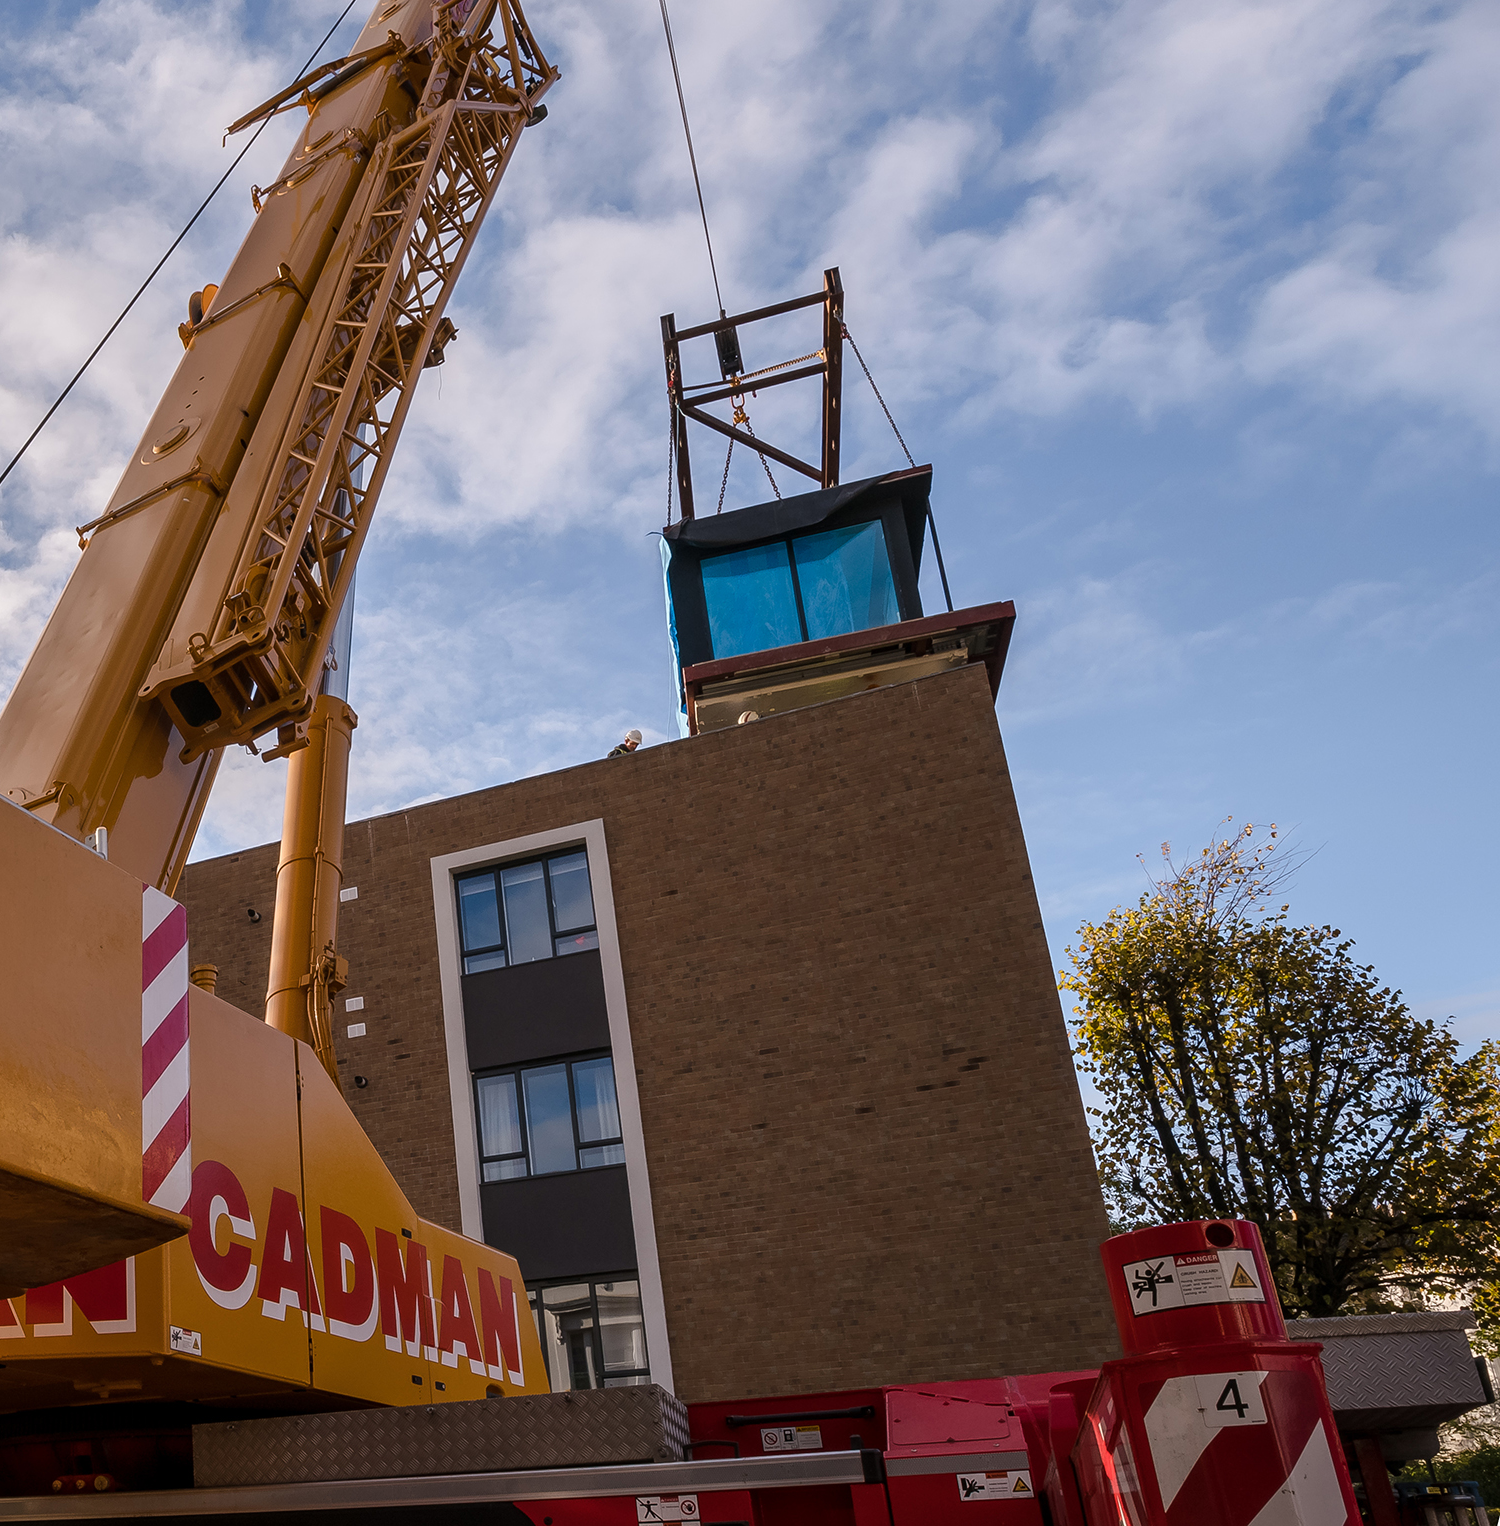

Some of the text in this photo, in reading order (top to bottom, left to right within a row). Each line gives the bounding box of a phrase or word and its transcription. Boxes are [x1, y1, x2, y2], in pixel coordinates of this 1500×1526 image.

[188, 1159, 526, 1388] CADMAN
[1186, 1254, 1218, 1264] DANGER
[1216, 1378, 1249, 1418] 4
